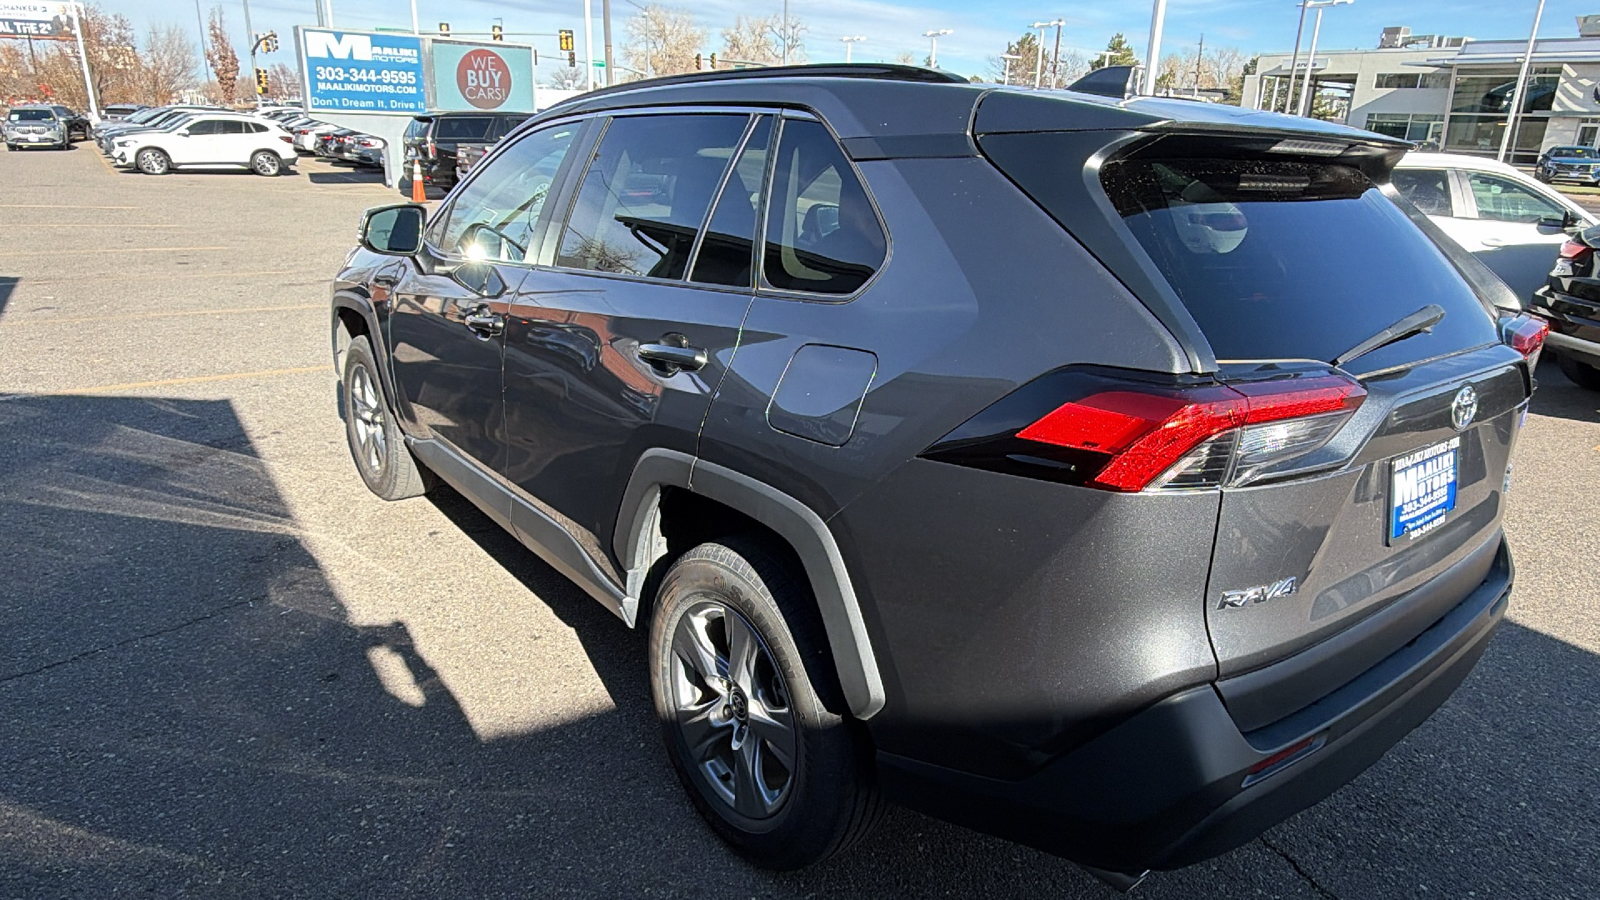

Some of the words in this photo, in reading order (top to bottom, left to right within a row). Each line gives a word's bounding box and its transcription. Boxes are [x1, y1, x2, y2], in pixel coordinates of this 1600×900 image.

[13, 22, 39, 34] THE
[372, 54, 419, 64] MOTORS
[471, 55, 497, 71] WE
[316, 66, 417, 84] 303-344-9595
[466, 69, 502, 87] BUY
[317, 82, 417, 94] MAALIKIMOTORS.COM
[465, 86, 506, 101] CARS!
[312, 97, 339, 106] Don't
[342, 98, 374, 108] Dream
[377, 100, 388, 109] It,
[390, 100, 415, 109] Drive
[1217, 576, 1297, 610] RAV4
